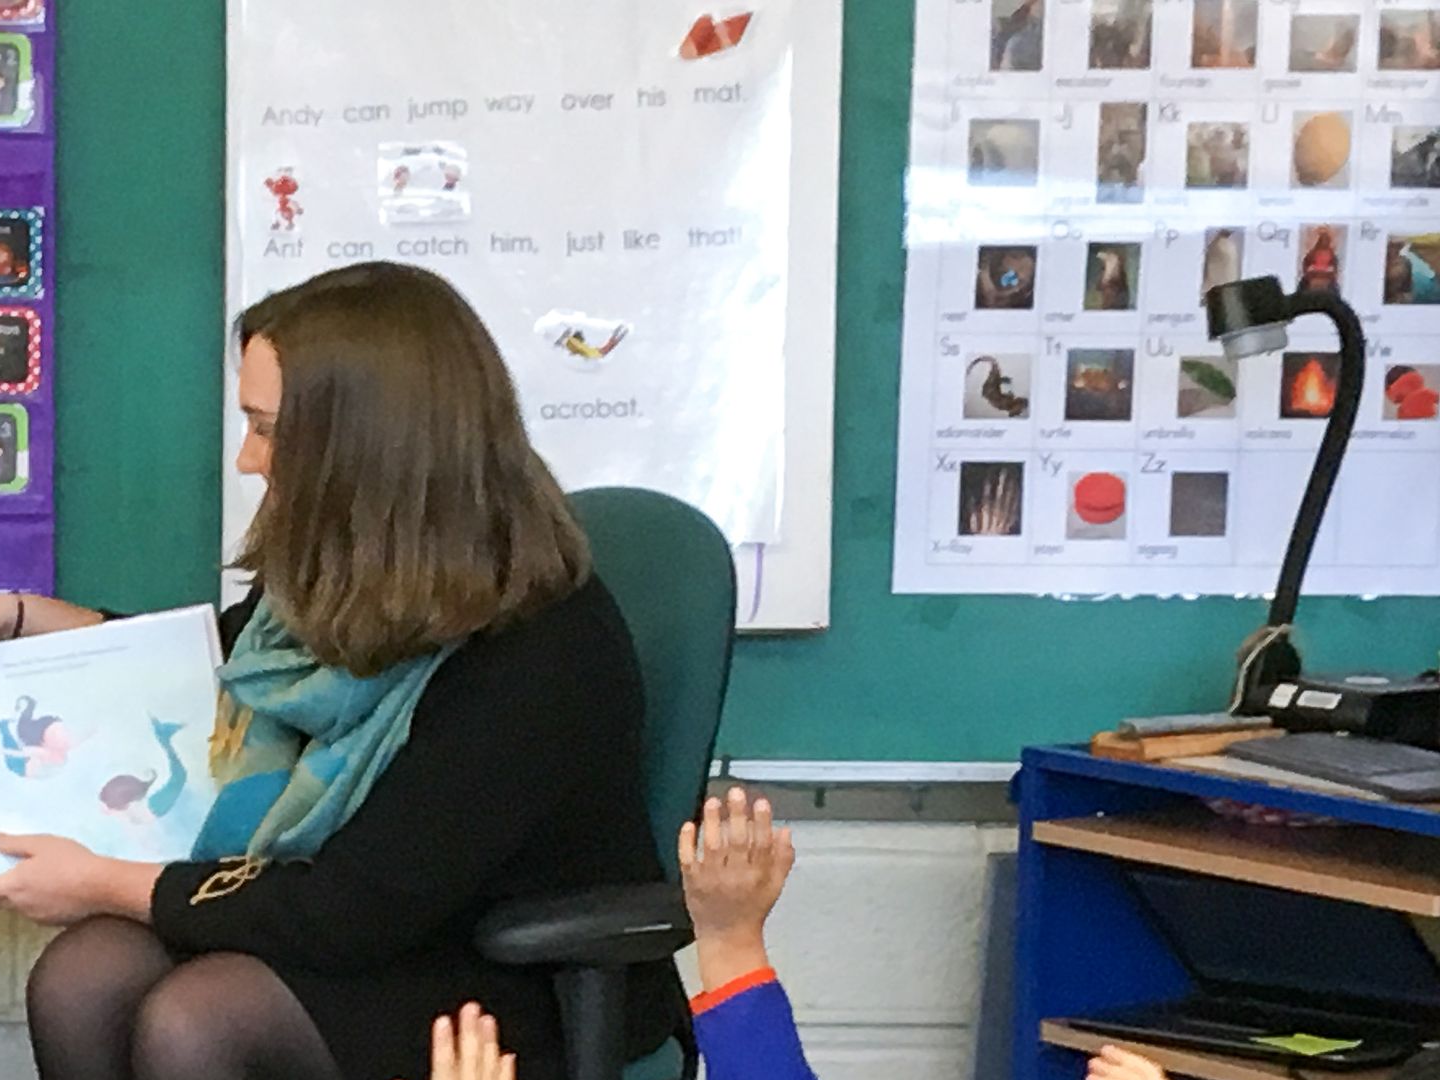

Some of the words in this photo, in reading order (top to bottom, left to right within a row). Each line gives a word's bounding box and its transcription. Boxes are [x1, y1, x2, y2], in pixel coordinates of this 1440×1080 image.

[260, 104, 324, 127] Andy
[342, 103, 391, 124] can
[406, 95, 469, 124] jump
[484, 95, 535, 114] way
[560, 92, 614, 111] over
[636, 85, 667, 108] his
[262, 236, 304, 259] Ant
[326, 239, 374, 259] can
[396, 234, 469, 257] catch
[490, 230, 540, 254] him,
[565, 229, 605, 257] just
[622, 228, 661, 251] like
[540, 397, 644, 420] acrobat.
[1140, 452, 1168, 474] Zz
